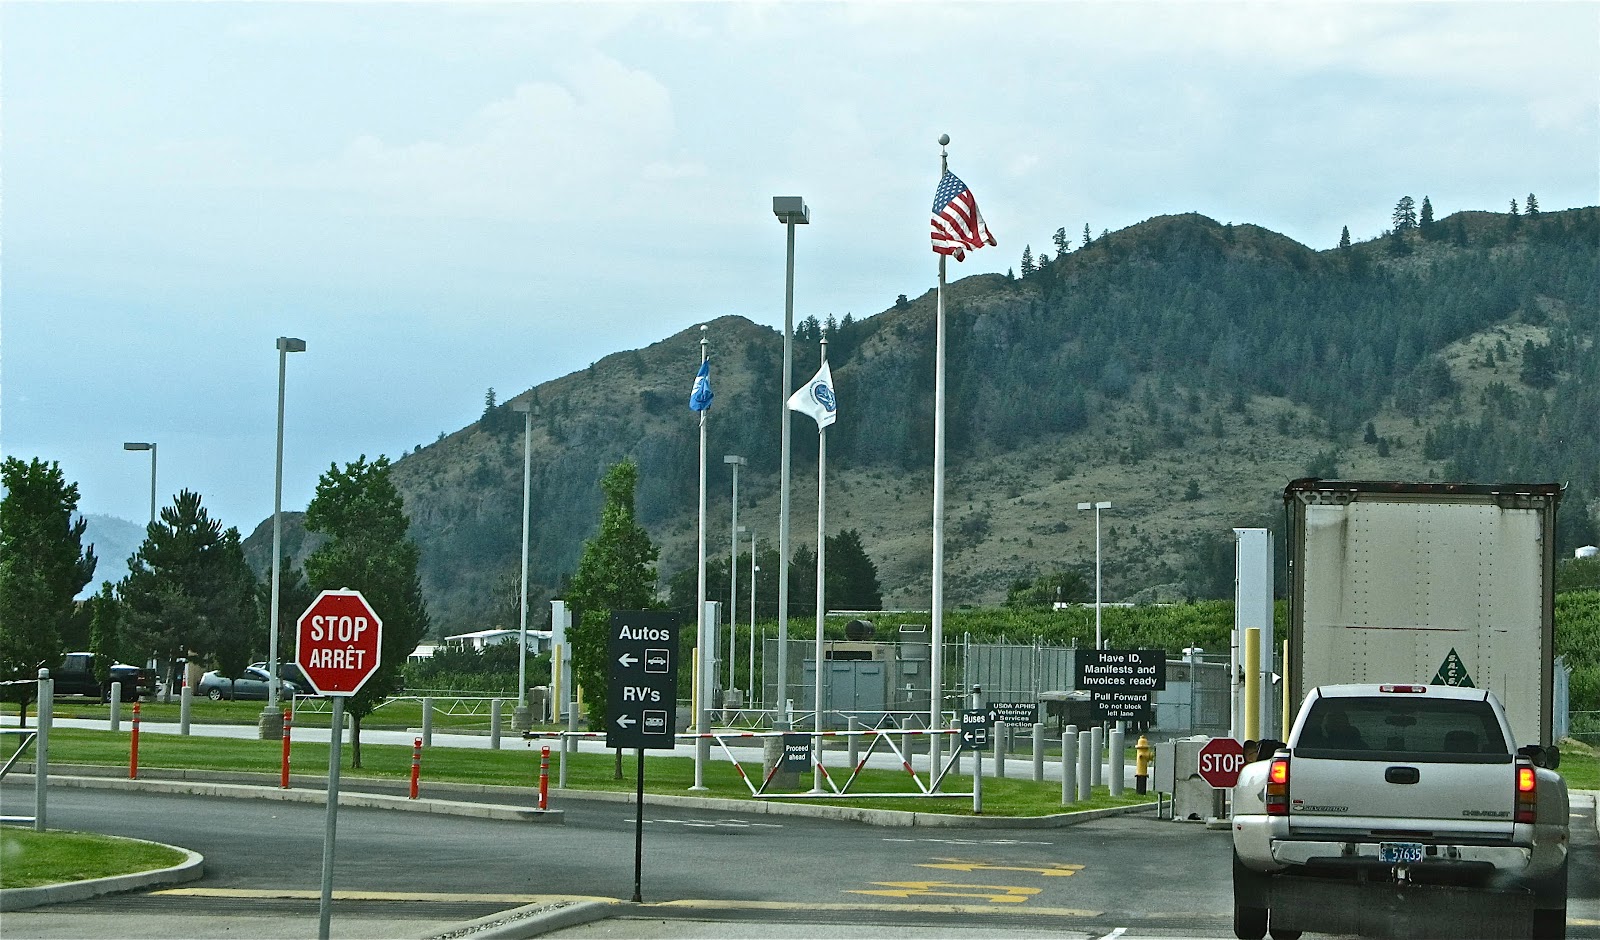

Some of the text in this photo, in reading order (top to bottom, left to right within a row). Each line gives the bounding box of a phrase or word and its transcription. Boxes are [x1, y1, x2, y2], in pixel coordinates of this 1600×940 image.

[311, 615, 368, 642] STOP
[619, 625, 670, 641] Autos
[309, 645, 366, 670] ARRÊT
[1099, 653, 1142, 664] Have ID,
[1084, 664, 1156, 674] Manifests and
[1083, 676, 1157, 687] Invoices ready
[623, 686, 661, 702] RV's
[1094, 692, 1147, 702] Pull Forward
[963, 714, 986, 723] Buses
[1201, 753, 1245, 773] STOP
[1392, 847, 1421, 860] 57635
